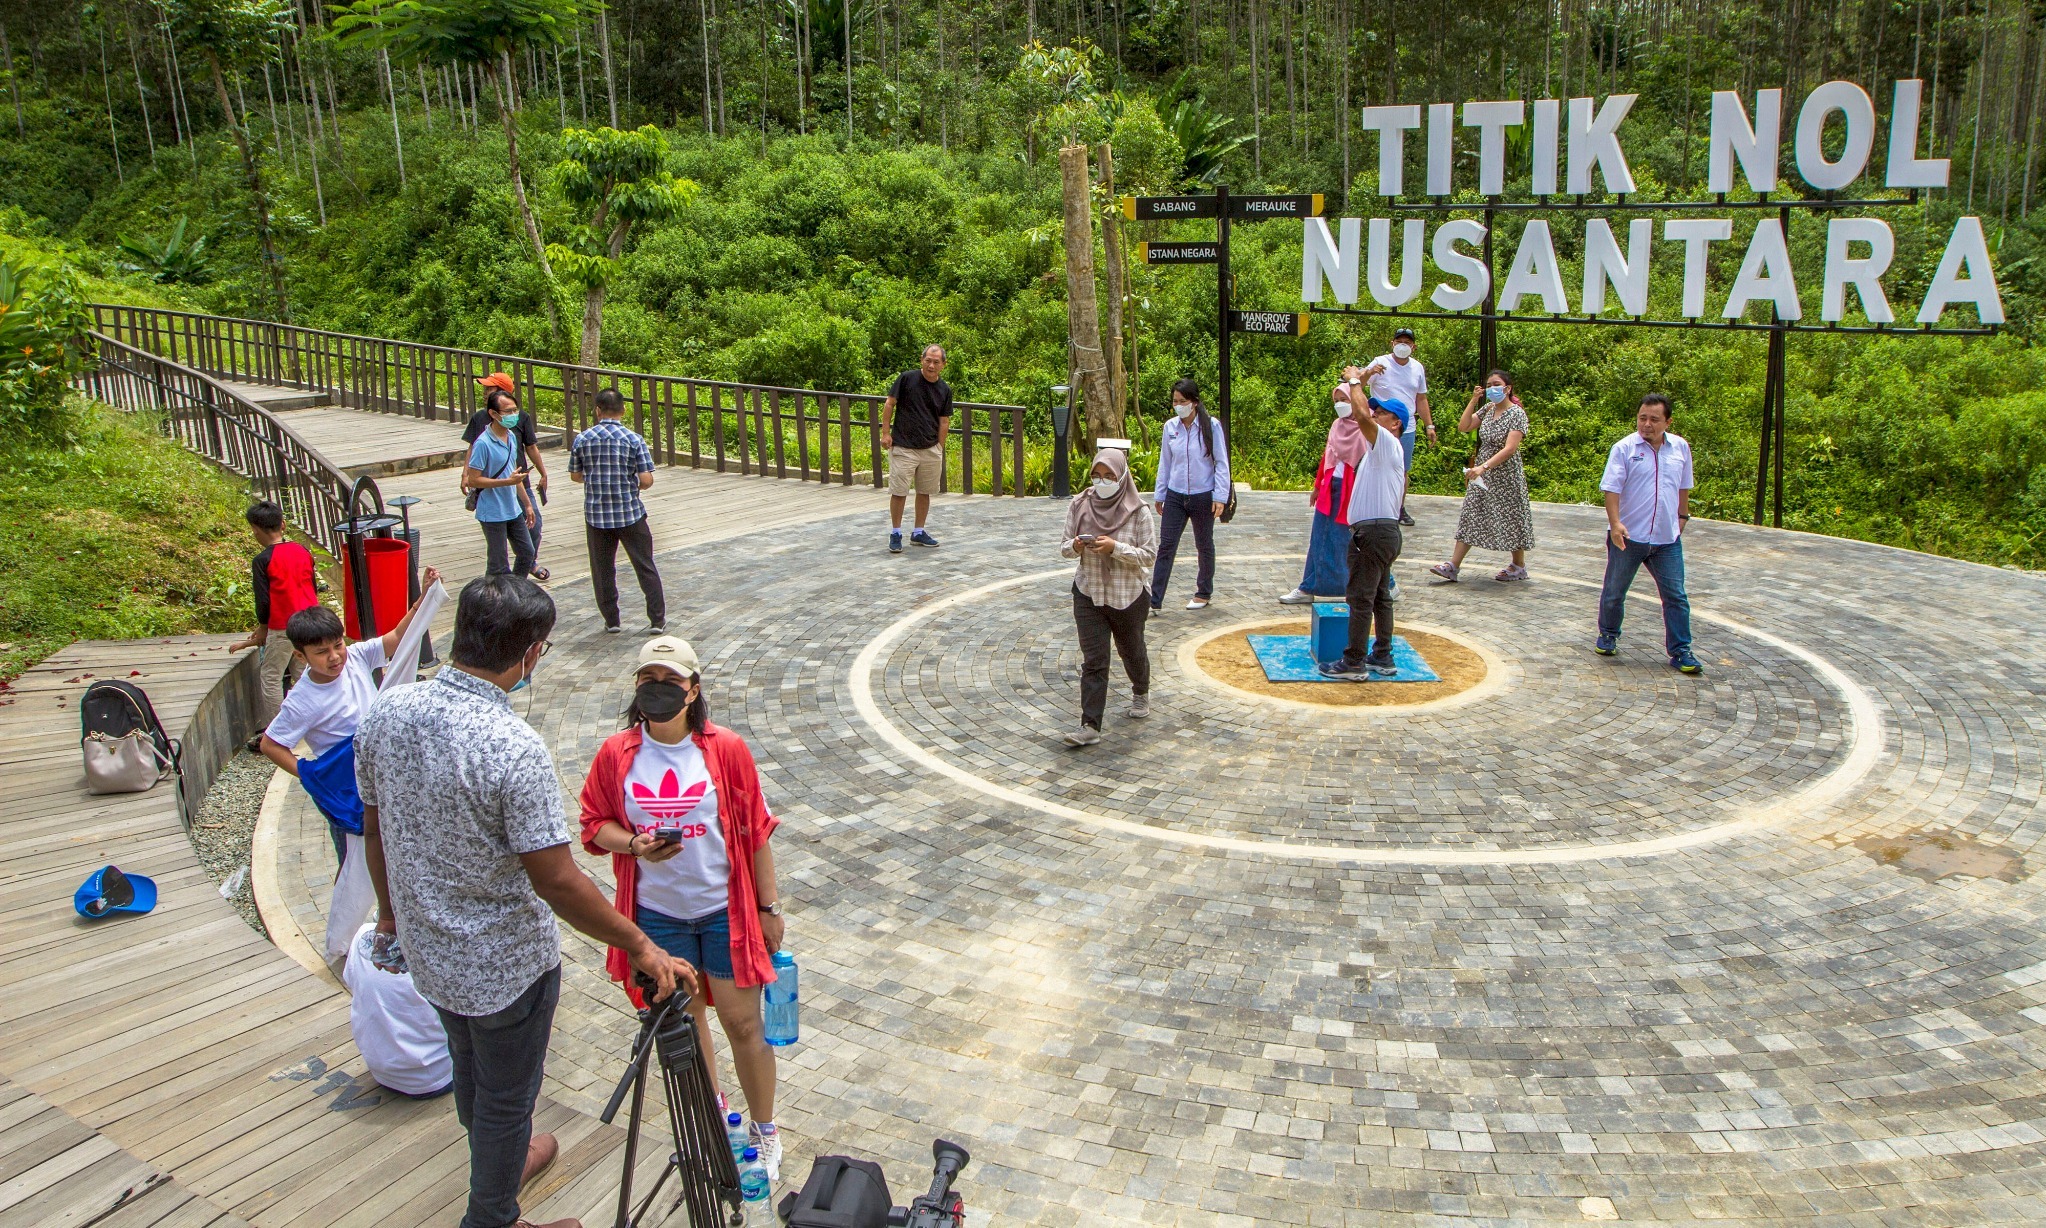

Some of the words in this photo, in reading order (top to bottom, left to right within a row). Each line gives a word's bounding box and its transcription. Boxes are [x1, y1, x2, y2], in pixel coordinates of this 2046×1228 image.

[1363, 93, 1638, 197] TITIK
[1709, 79, 1950, 193] NOL
[1153, 202, 1196, 212] SABANG
[1246, 201, 1296, 212] MERAUKE
[1148, 249, 1180, 259] ISTANA
[1181, 248, 1217, 258] NEGARA
[1302, 217, 2005, 324] NUSANTARA
[1241, 312, 1291, 324] MANGROVE
[1245, 321, 1263, 331] ECO
[1264, 323, 1288, 333] PARK
[636, 821, 707, 839] adas
